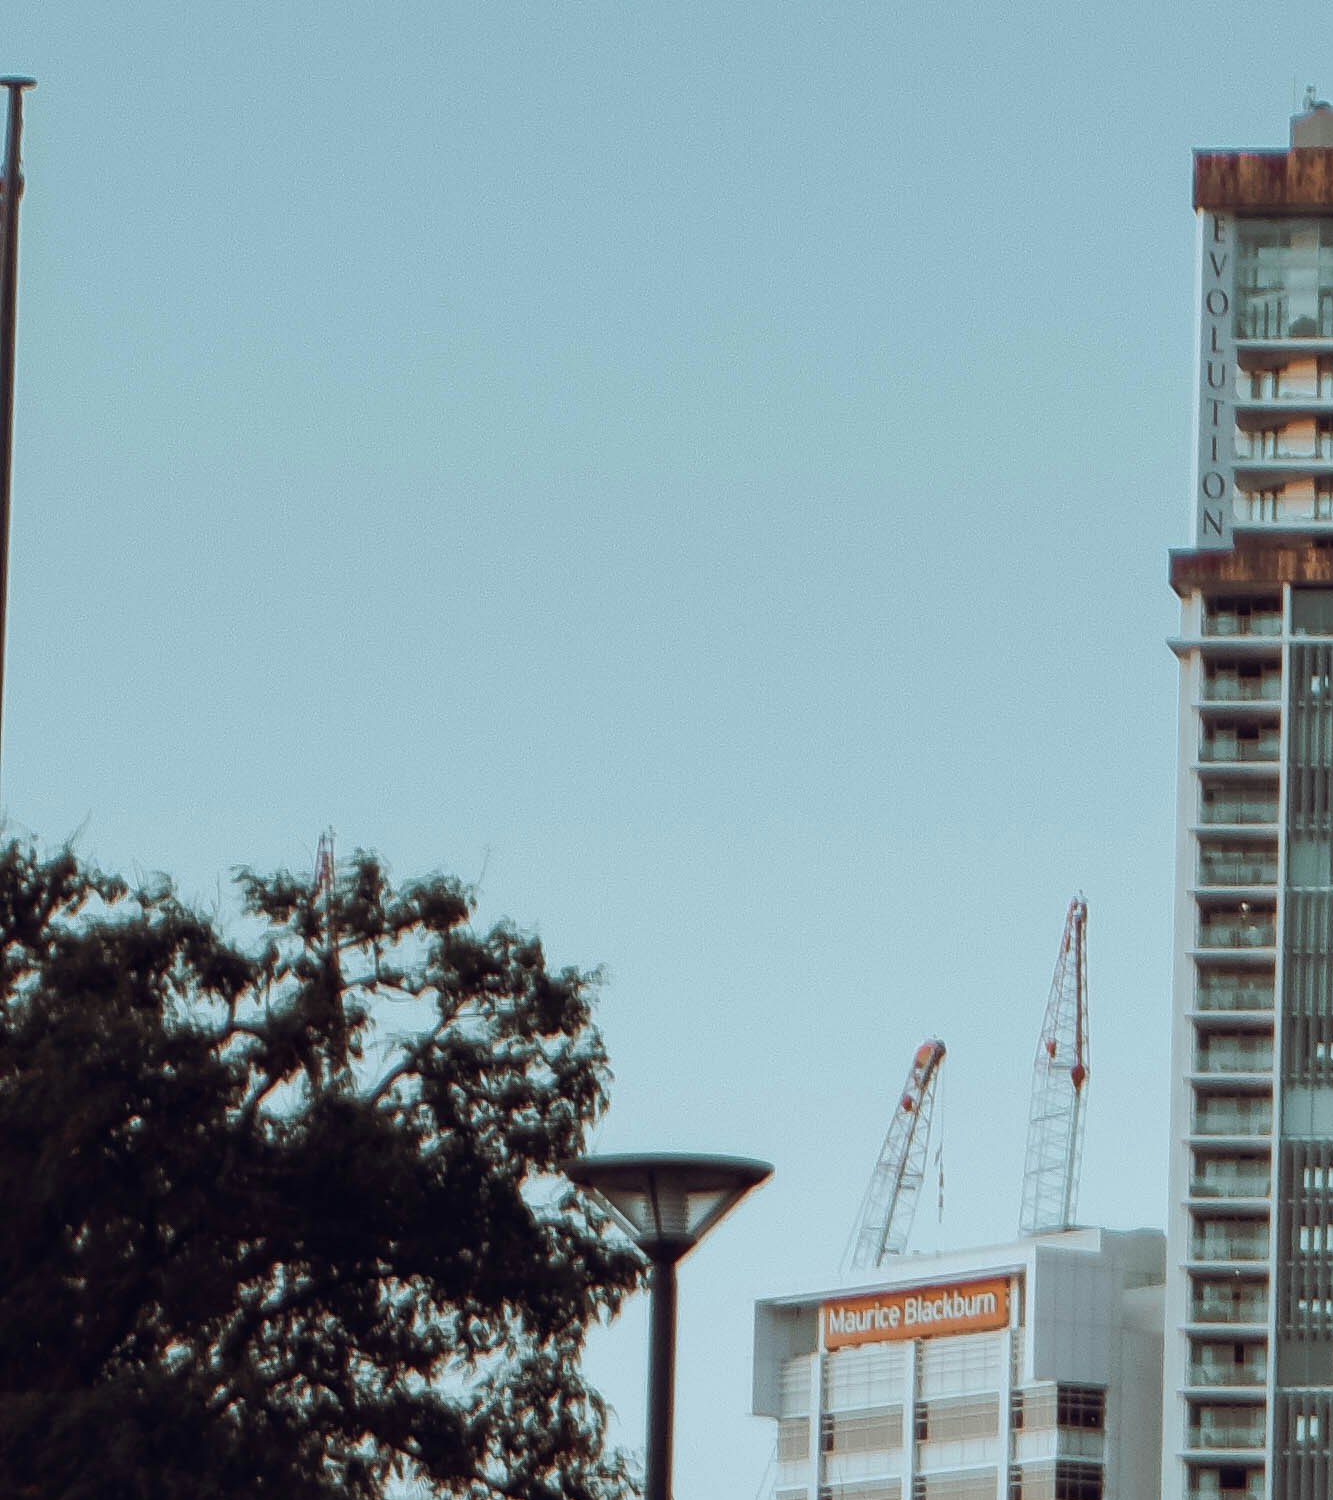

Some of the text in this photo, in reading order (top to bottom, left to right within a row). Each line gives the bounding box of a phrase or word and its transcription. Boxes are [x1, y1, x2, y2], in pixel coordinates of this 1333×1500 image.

[1202, 214, 1229, 536] EVOLUTION
[829, 1289, 996, 1336] Maurice Blackburn
